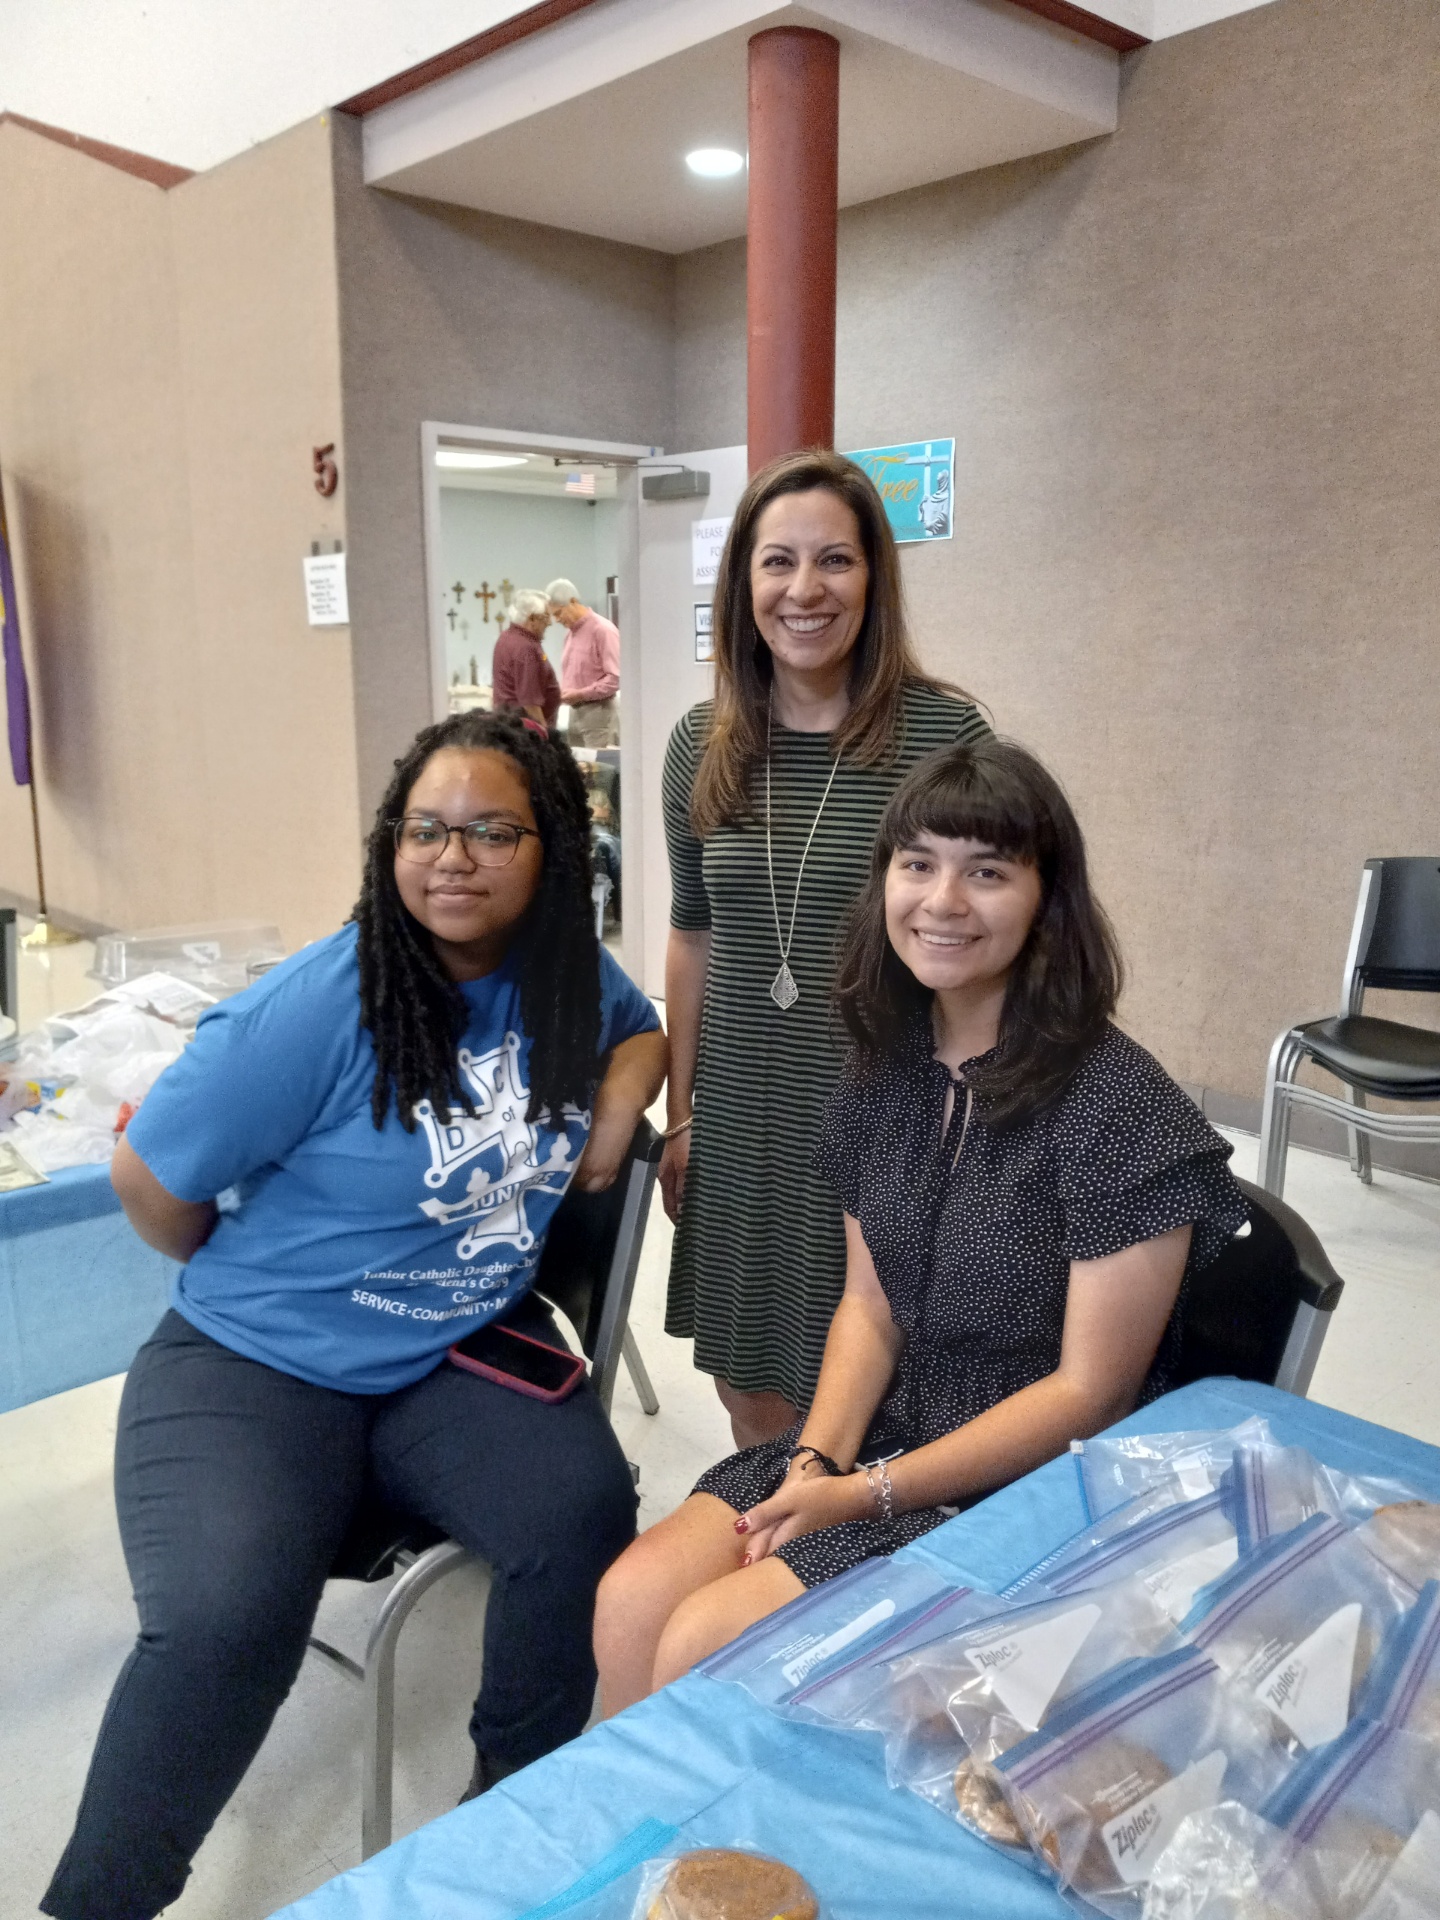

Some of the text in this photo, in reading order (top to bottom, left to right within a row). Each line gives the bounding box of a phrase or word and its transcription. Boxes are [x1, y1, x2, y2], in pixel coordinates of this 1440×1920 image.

[312, 442, 339, 498] 5
[695, 526, 724, 539] PLEASE
[710, 546, 721, 557] FO
[695, 566, 717, 578] ASSIS
[492, 1065, 504, 1093] C
[446, 1126, 464, 1150] D
[362, 1270, 408, 1281] Junior
[409, 1268, 461, 1281] Catholic
[464, 1261, 516, 1279] Daughte
[974, 1644, 1012, 1670] Ziploc
[1266, 1663, 1301, 1710] Ziploc
[1111, 1808, 1154, 1859] Ziploc
